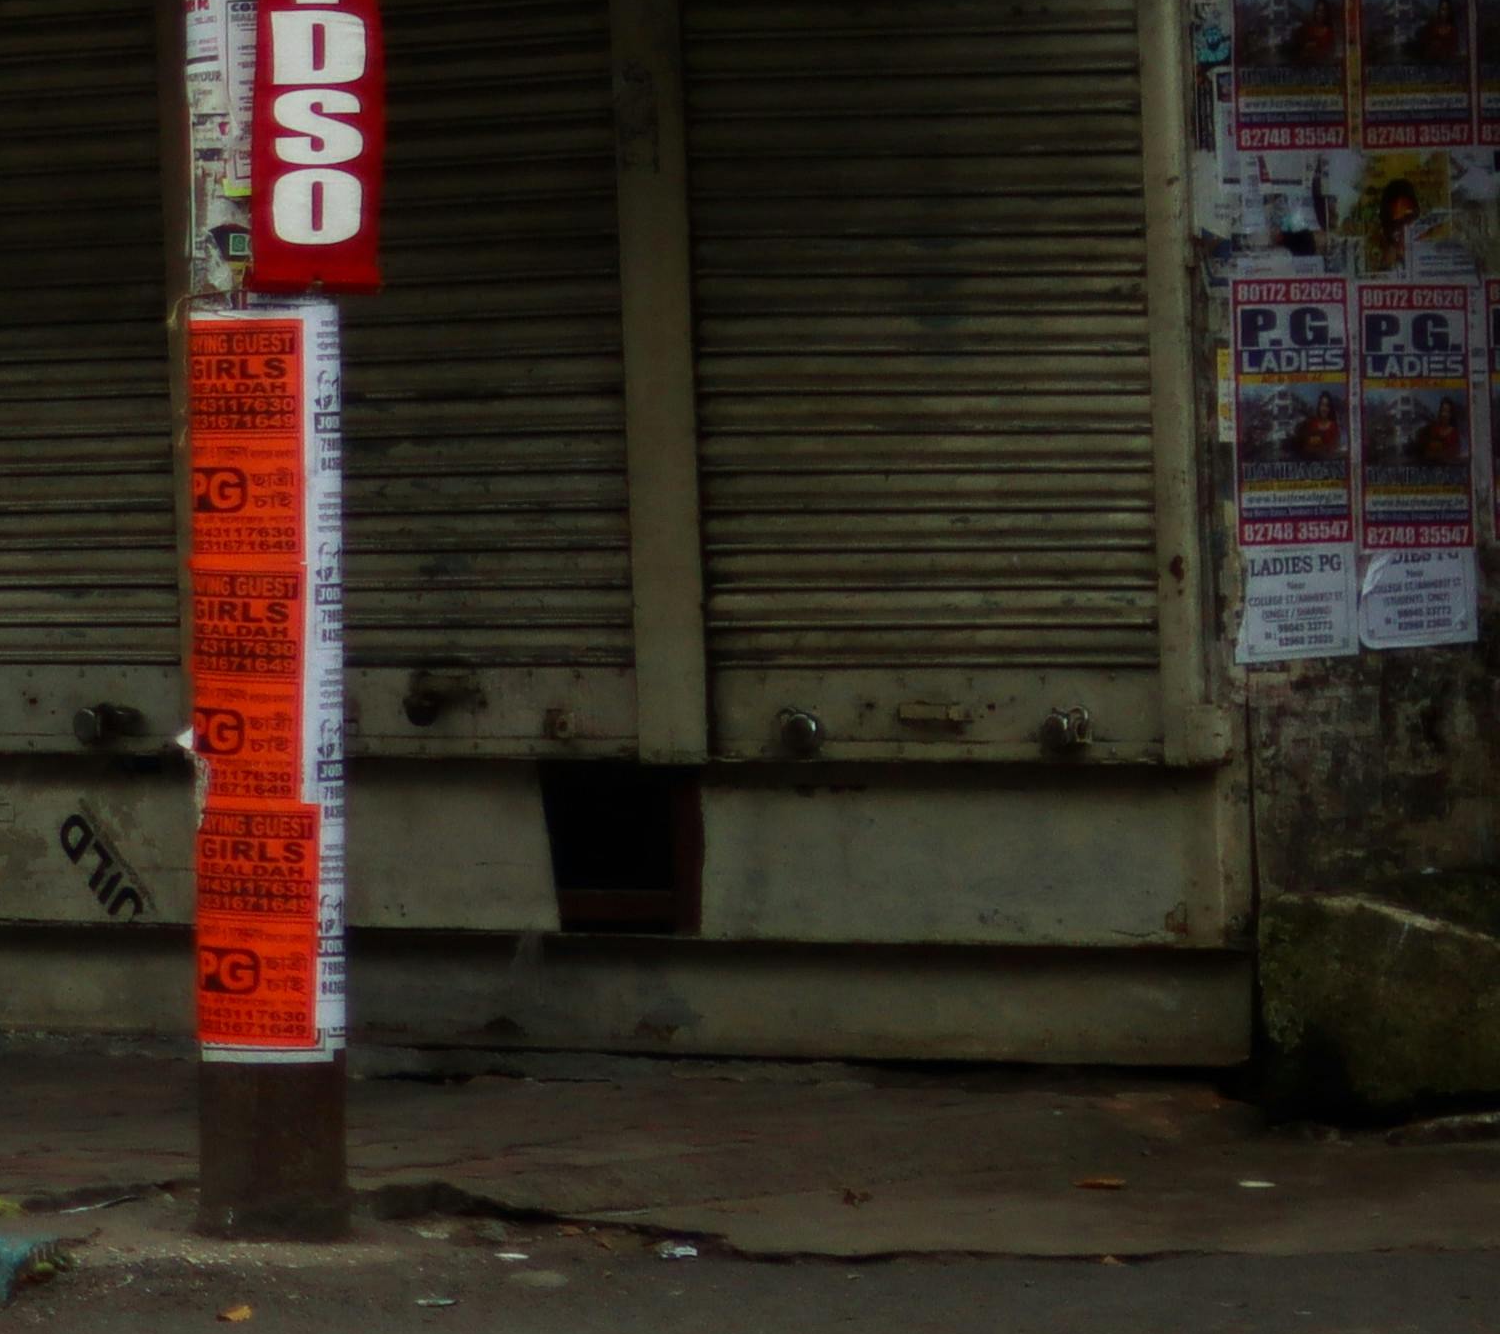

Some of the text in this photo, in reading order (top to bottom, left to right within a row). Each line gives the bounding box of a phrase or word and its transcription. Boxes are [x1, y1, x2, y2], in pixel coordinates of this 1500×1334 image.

[1237, 281, 1343, 302] 80172 62626
[1362, 287, 1464, 308] 80172 62626
[1240, 306, 1344, 348] P.G.
[1364, 313, 1463, 353] P.G.
[233, 334, 293, 354] GUEST
[193, 357, 287, 380] GIRLS
[1242, 349, 1346, 373] LADIES
[1366, 354, 1465, 378] LADIES
[1243, 519, 1350, 542] 82748 35547
[1367, 524, 1470, 546] 82748 35547
[1250, 553, 1343, 578] LADIES PG
[235, 577, 297, 598] GUEST
[196, 600, 290, 624] GIRLS
[251, 816, 313, 837] GUEST
[203, 839, 305, 864] GIRLS
